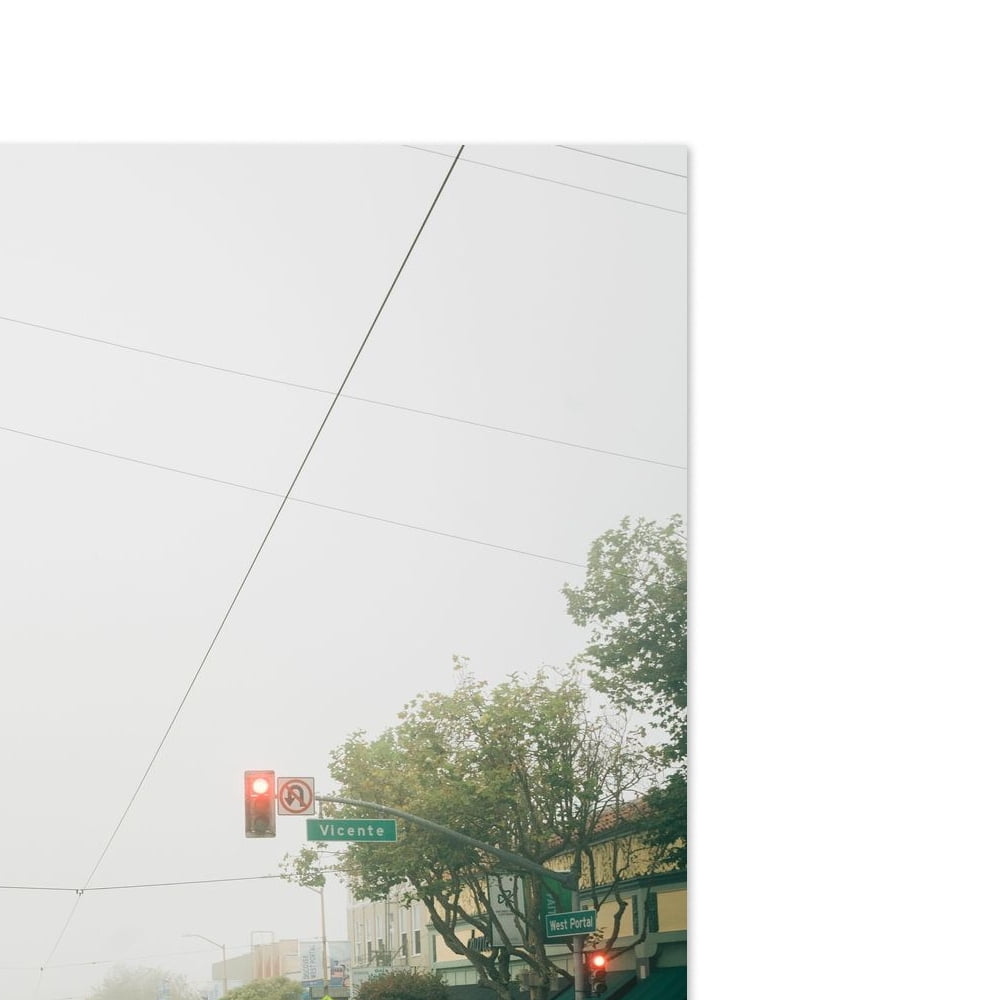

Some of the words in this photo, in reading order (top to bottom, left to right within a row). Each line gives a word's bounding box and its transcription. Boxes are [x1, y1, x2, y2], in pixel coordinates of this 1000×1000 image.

[319, 824, 385, 837] Vicente
[549, 919, 568, 932] West
[570, 915, 593, 930] Portal
